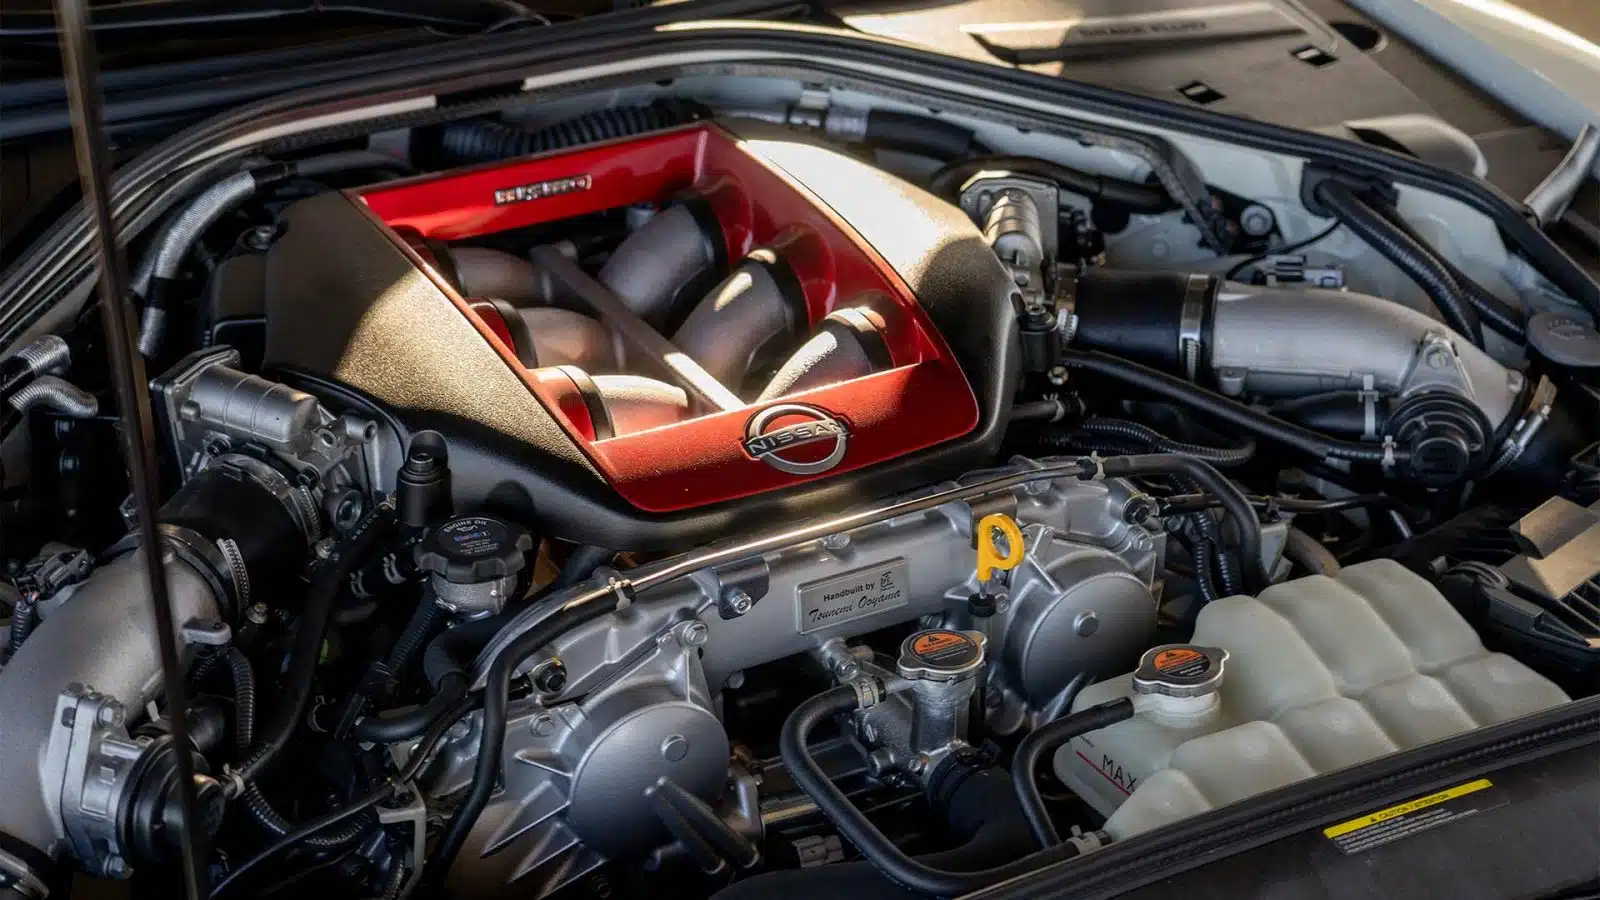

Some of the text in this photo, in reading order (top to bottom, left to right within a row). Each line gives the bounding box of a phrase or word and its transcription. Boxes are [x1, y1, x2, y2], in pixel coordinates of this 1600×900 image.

[747, 421, 847, 454] NISSAN
[443, 520, 473, 533] ENGINE
[823, 585, 864, 602] Handbuilt
[865, 582, 876, 592] by
[1102, 753, 1137, 793] MAX
